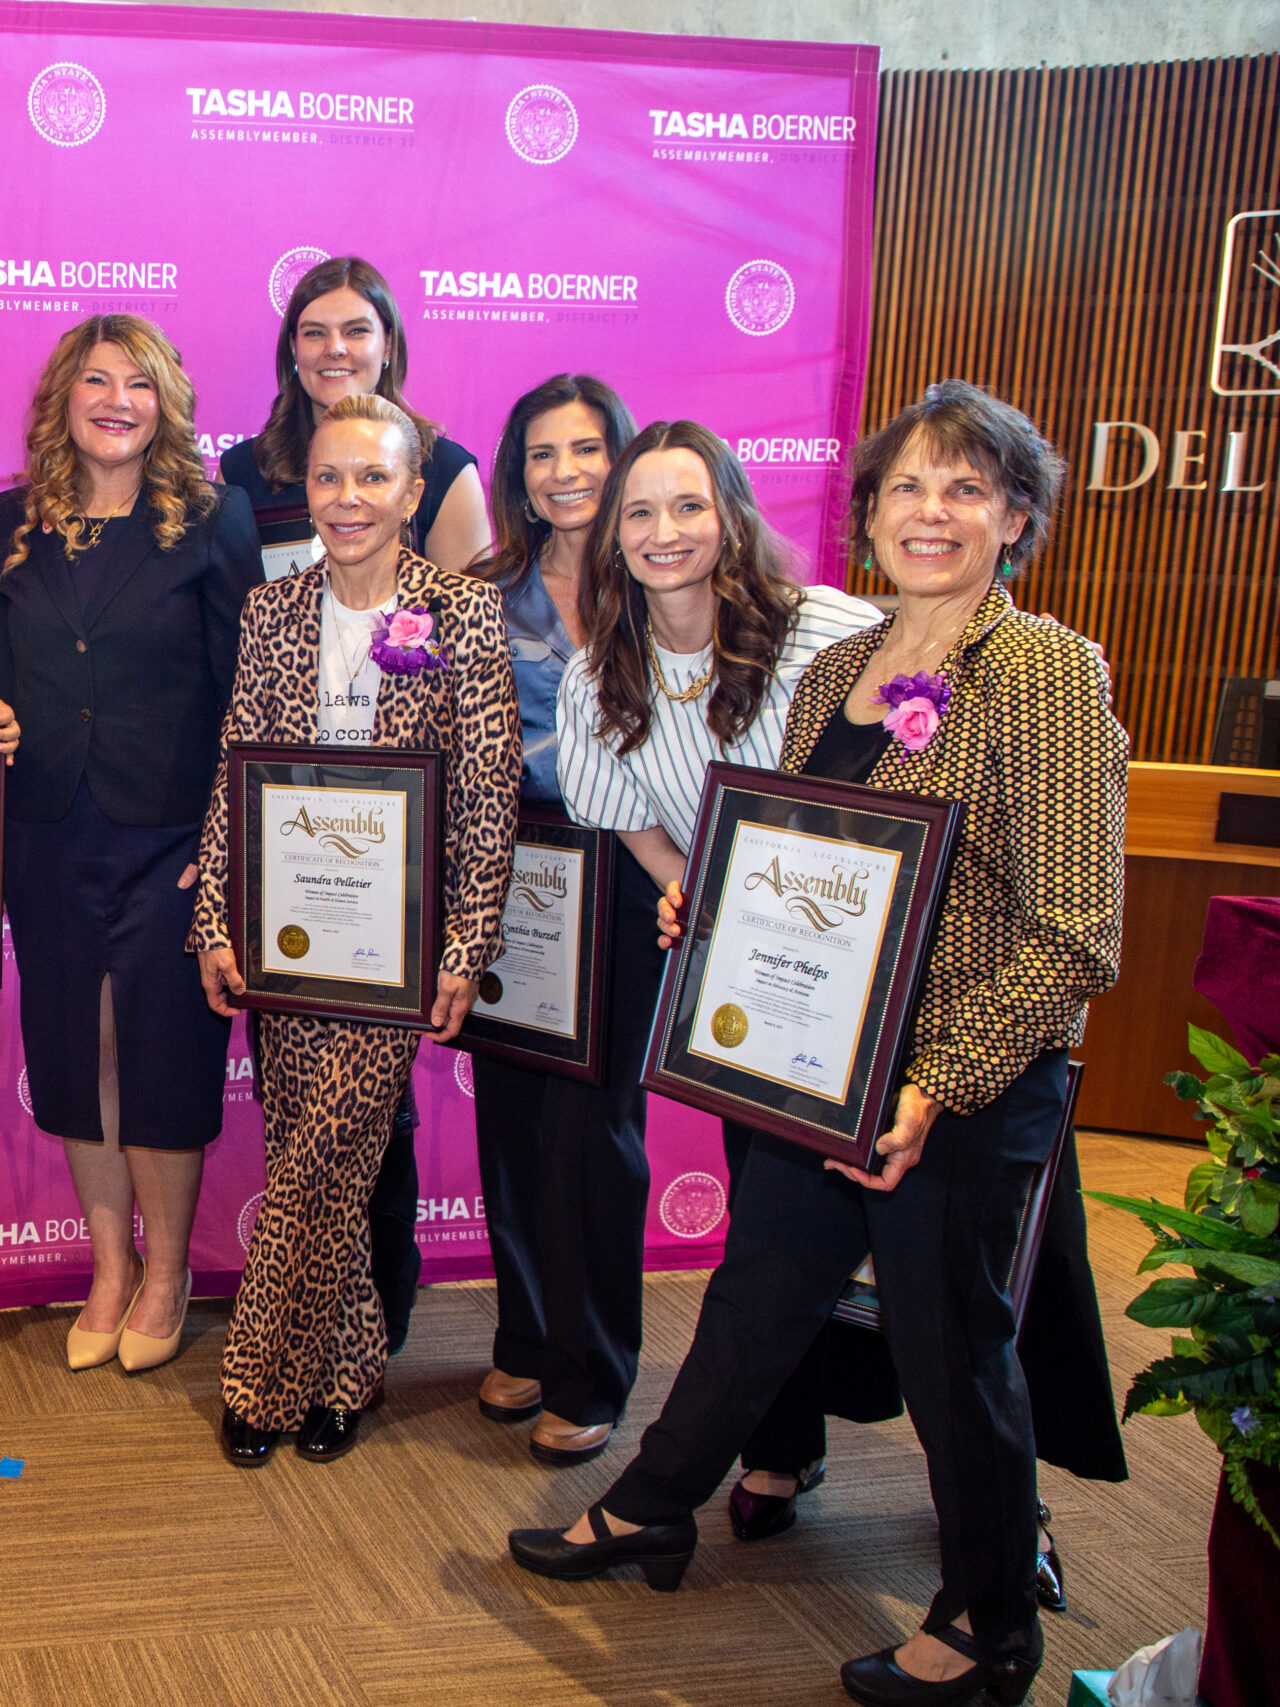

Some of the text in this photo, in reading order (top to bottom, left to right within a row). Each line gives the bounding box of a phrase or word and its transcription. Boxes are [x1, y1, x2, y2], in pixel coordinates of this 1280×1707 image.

[186, 88, 413, 126] TASHA BOERNER
[191, 129, 322, 144] ASSEMBLYMEMBER,
[649, 110, 856, 141] TASHA BOERNER
[653, 149, 773, 162] ASSEMBLYMEMBER,
[61, 262, 177, 289] BOERNER
[420, 271, 637, 300] TASHA BOERNER
[423, 309, 549, 322] ASSEMBLYMEMBER,
[735, 438, 839, 465] BOERNER
[325, 691, 370, 707] laws
[280, 805, 385, 843] Assembly
[744, 836, 801, 854] CALIFORNIA
[284, 854, 324, 863] CERTIFICATE
[335, 858, 380, 868] RECOGNITION
[294, 873, 372, 889] Saundra Pelletier
[509, 861, 567, 899] ssembly
[744, 855, 869, 917] Assembly
[502, 923, 561, 942] Cynthia Burzell
[742, 914, 852, 947] CERTIFICATE OF RECOGNITION
[748, 948, 830, 981] Jennifer Phelps
